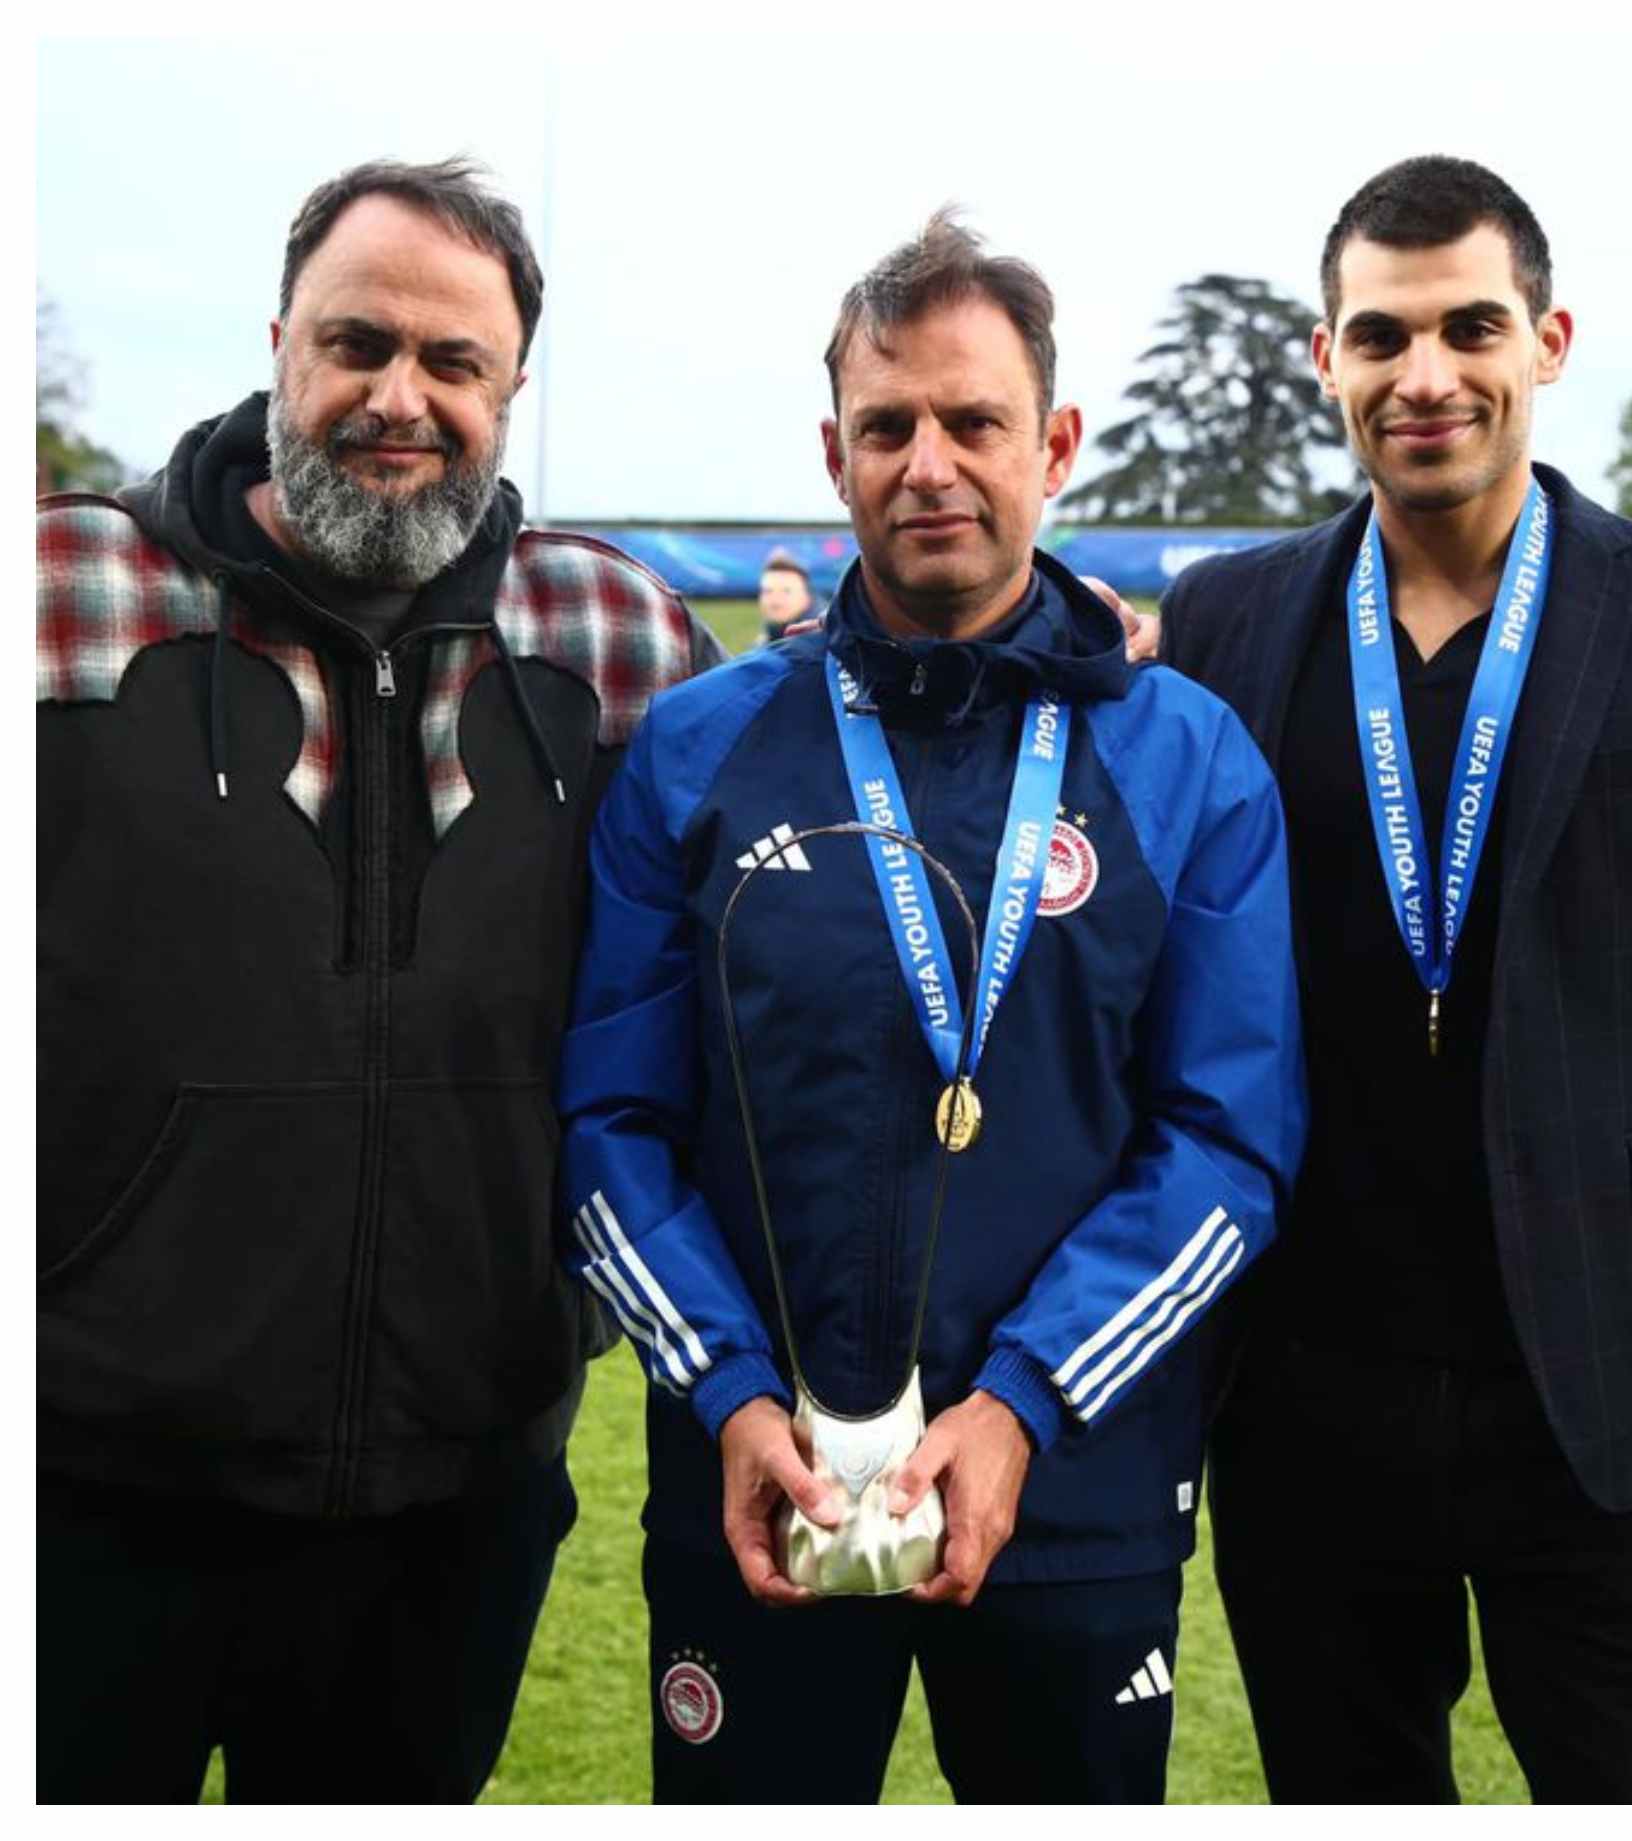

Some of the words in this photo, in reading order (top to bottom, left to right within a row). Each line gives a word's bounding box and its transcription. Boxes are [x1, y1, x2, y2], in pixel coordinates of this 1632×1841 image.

[1357, 589, 1380, 646] UEFA
[1498, 564, 1539, 655] LEAGUE
[1033, 697, 1060, 761] AGUE
[1368, 707, 1404, 800] LEAGUE
[1466, 715, 1500, 776] UEFA
[1010, 820, 1042, 880] UEFA
[1384, 804, 1420, 892] YOUTH
[1450, 781, 1485, 870] YOUTH
[889, 873, 933, 964] YOUTH
[992, 885, 1030, 975] YOUTH
[1403, 895, 1426, 957] UEFA
[917, 961, 949, 1028] UEFA
